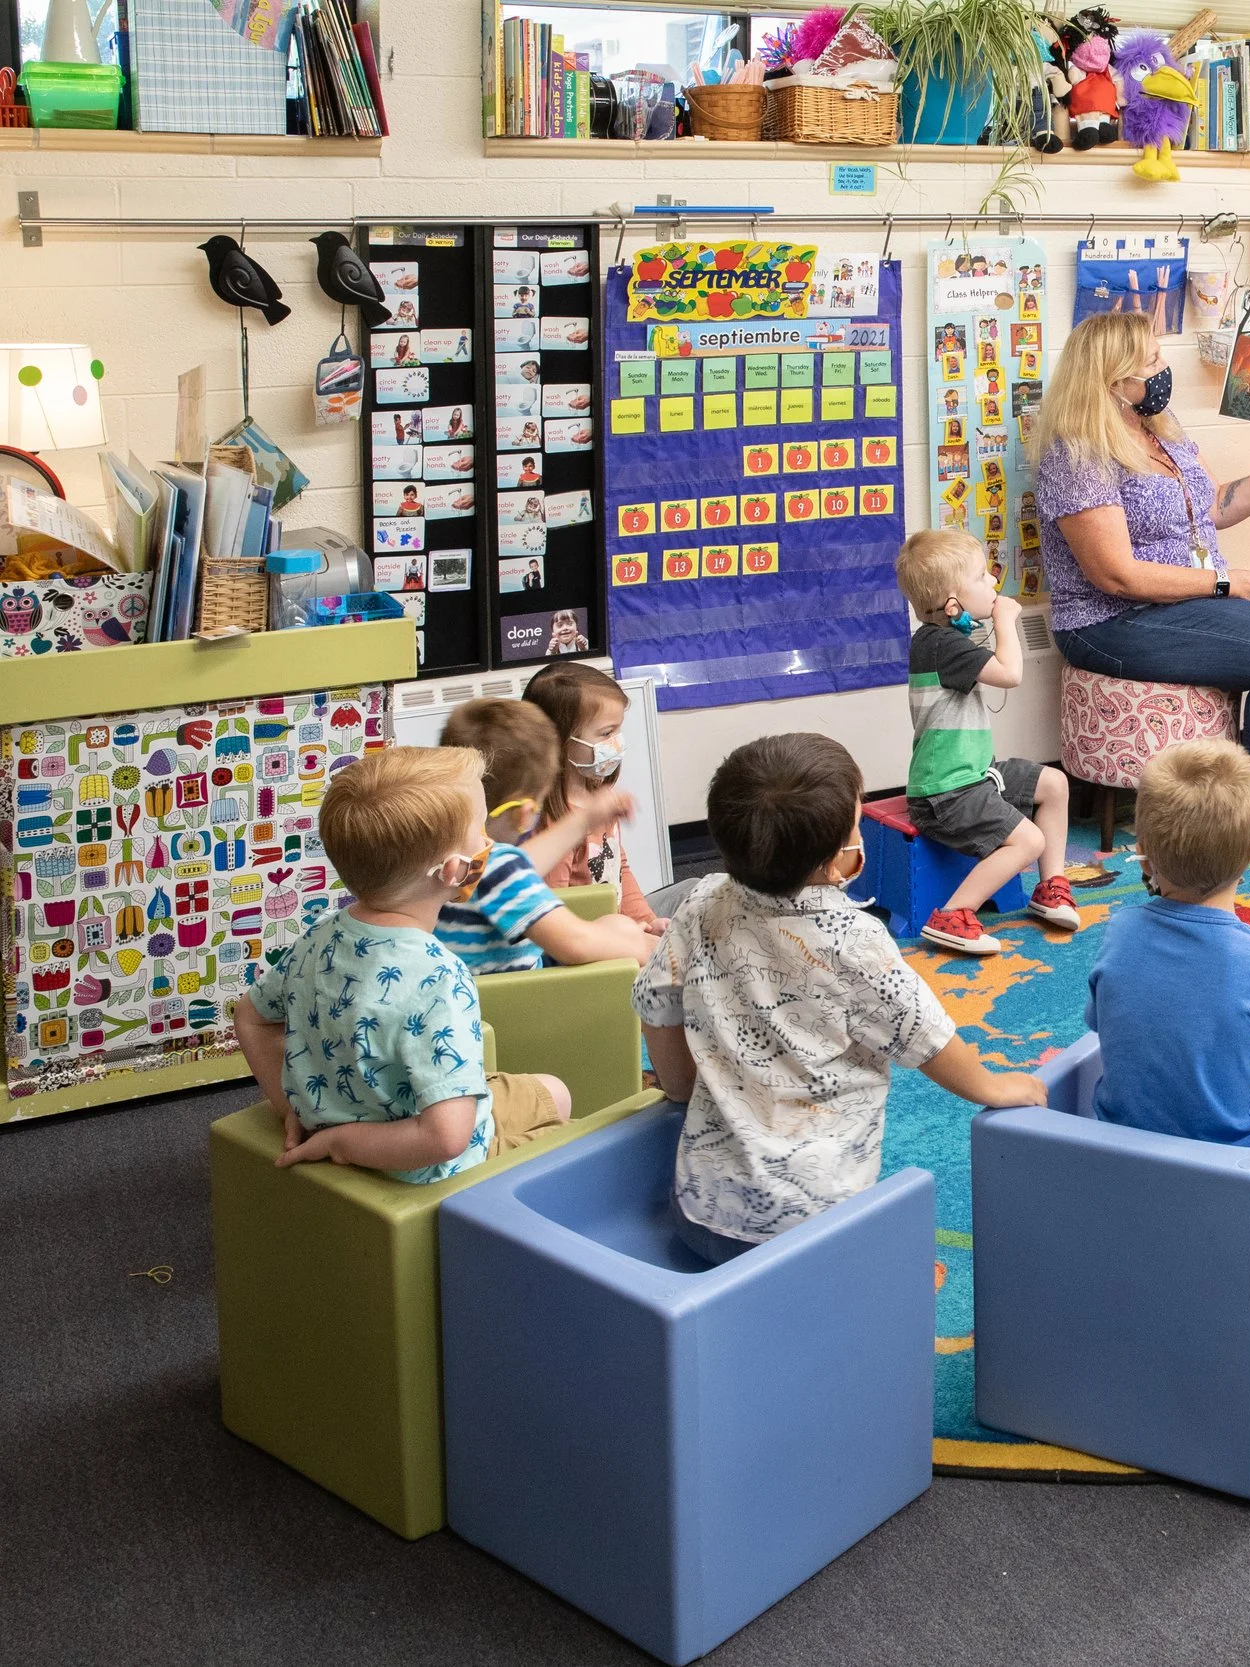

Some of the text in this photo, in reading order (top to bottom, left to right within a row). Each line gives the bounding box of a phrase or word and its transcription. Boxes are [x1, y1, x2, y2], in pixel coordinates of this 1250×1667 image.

[554, 62, 564, 134] kids' garden
[566, 72, 574, 122] Yoga Pretzels
[412, 232, 428, 240] Daily
[666, 269, 782, 289] SEPTEMBER
[947, 288, 998, 299] Class Helpers
[700, 328, 800, 349] septiembre
[850, 329, 886, 347] 2021
[834, 452, 840, 462] 3
[876, 448, 881, 459] 4
[757, 457, 762, 468] 1
[797, 455, 802, 465] 2
[798, 503, 804, 513] 9
[831, 500, 843, 510] 10
[871, 497, 881, 508] 11
[675, 513, 681, 523] 6
[715, 509, 720, 520] 7
[754, 507, 760, 518] 8
[633, 517, 639, 528] 5
[674, 561, 686, 572] 13
[714, 558, 725, 569] 14
[754, 556, 766, 567] 15
[624, 566, 636, 578] 12
[507, 626, 542, 640] done
